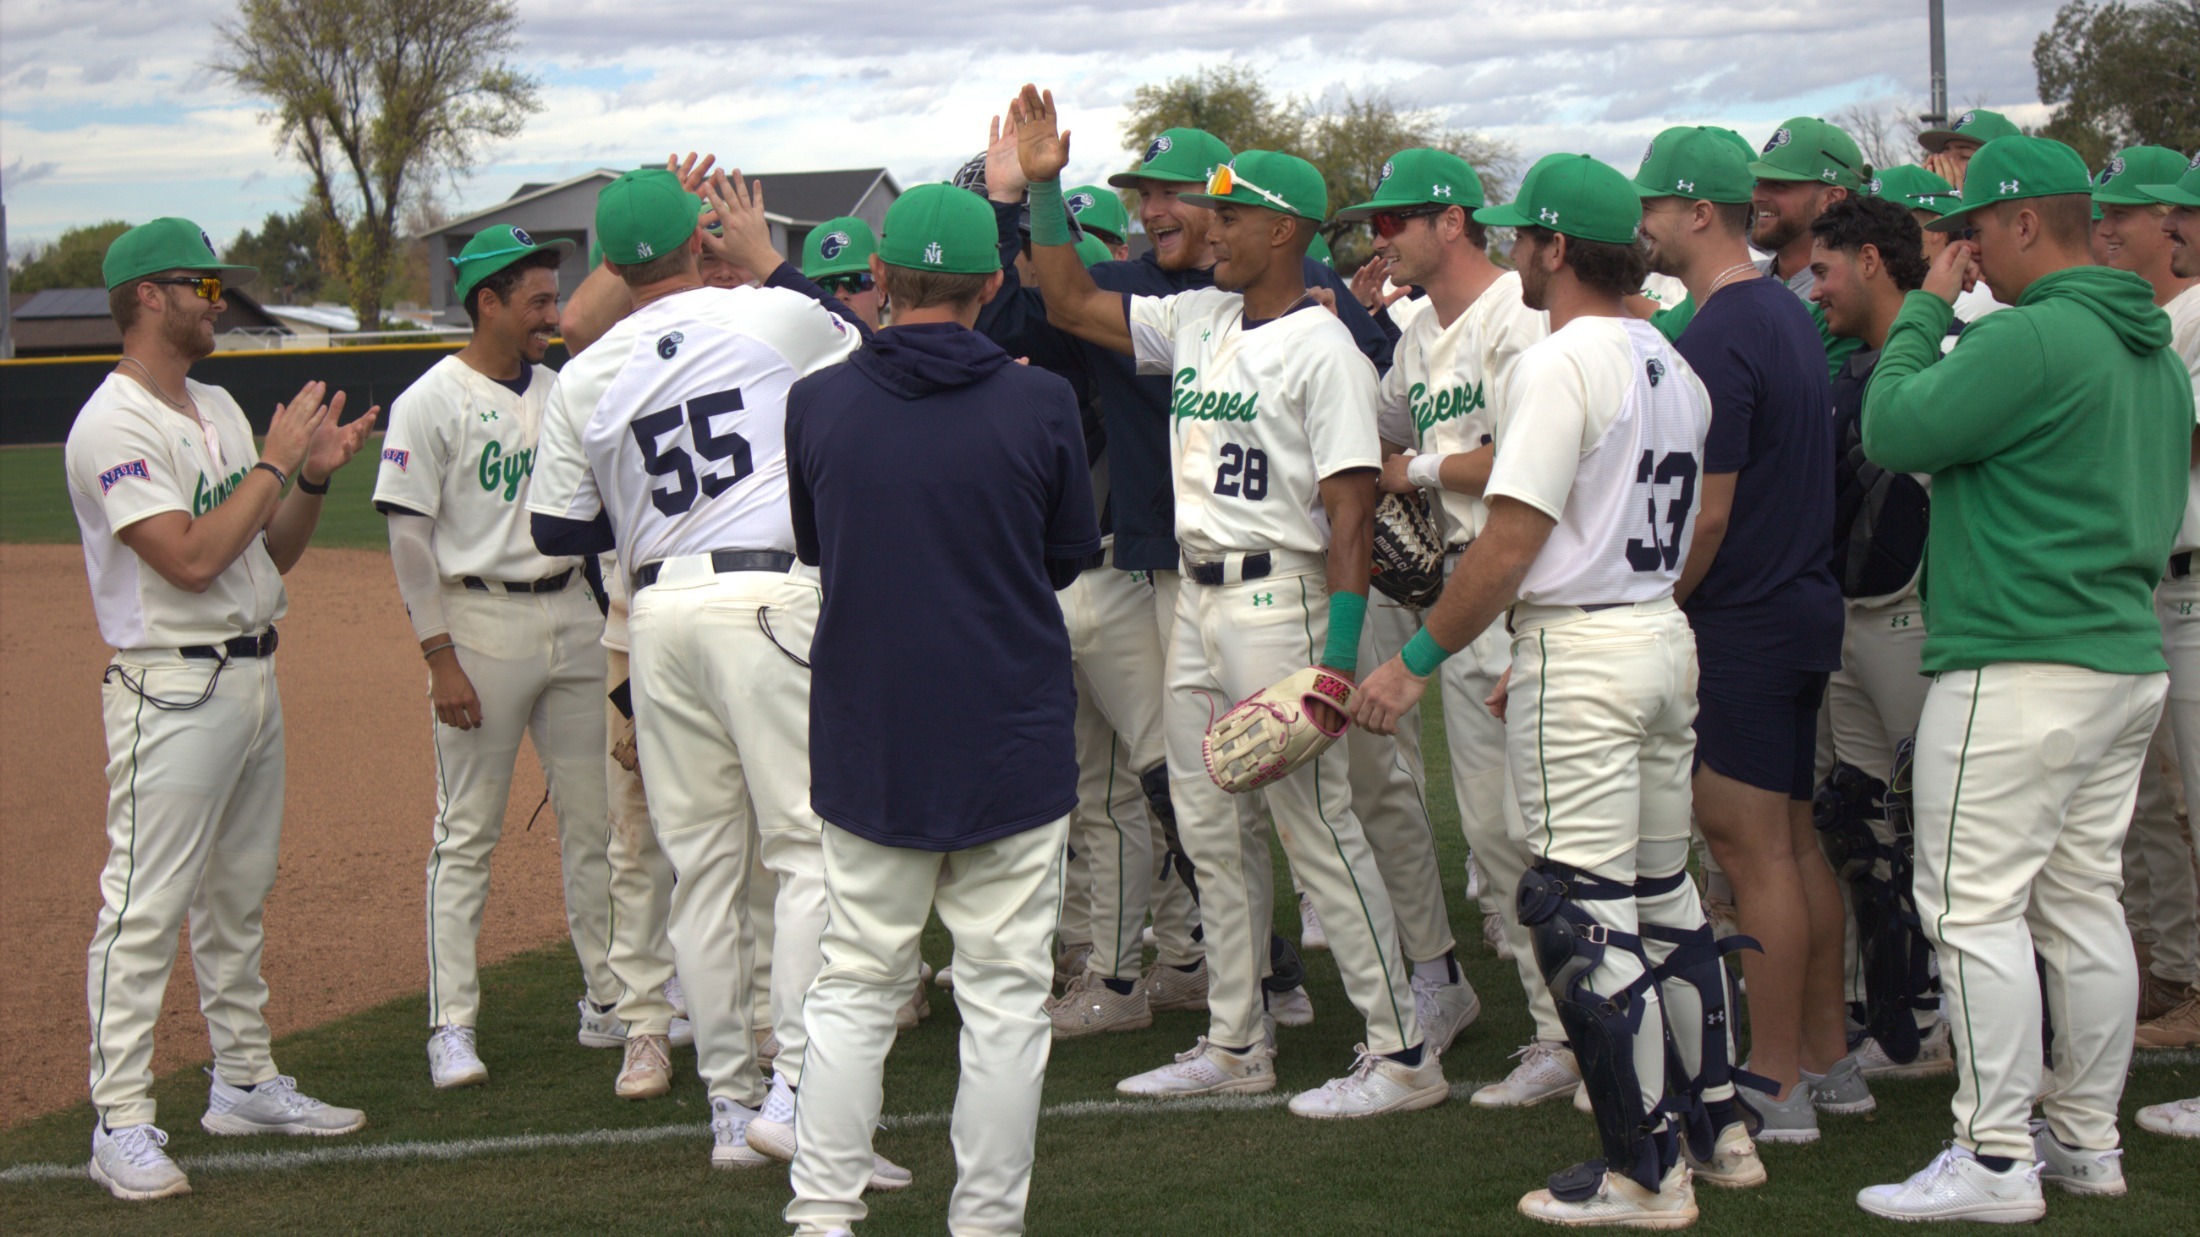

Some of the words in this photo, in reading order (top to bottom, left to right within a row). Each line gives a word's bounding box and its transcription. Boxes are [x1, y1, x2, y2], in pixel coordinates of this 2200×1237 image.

[100, 461, 149, 492] NAIA
[479, 440, 539, 503] Gyr
[630, 387, 754, 518] 55
[1213, 442, 1269, 502] 28
[1625, 449, 1698, 572] 33
[1375, 535, 1414, 573] marucci
[1249, 754, 1289, 787] marucci
